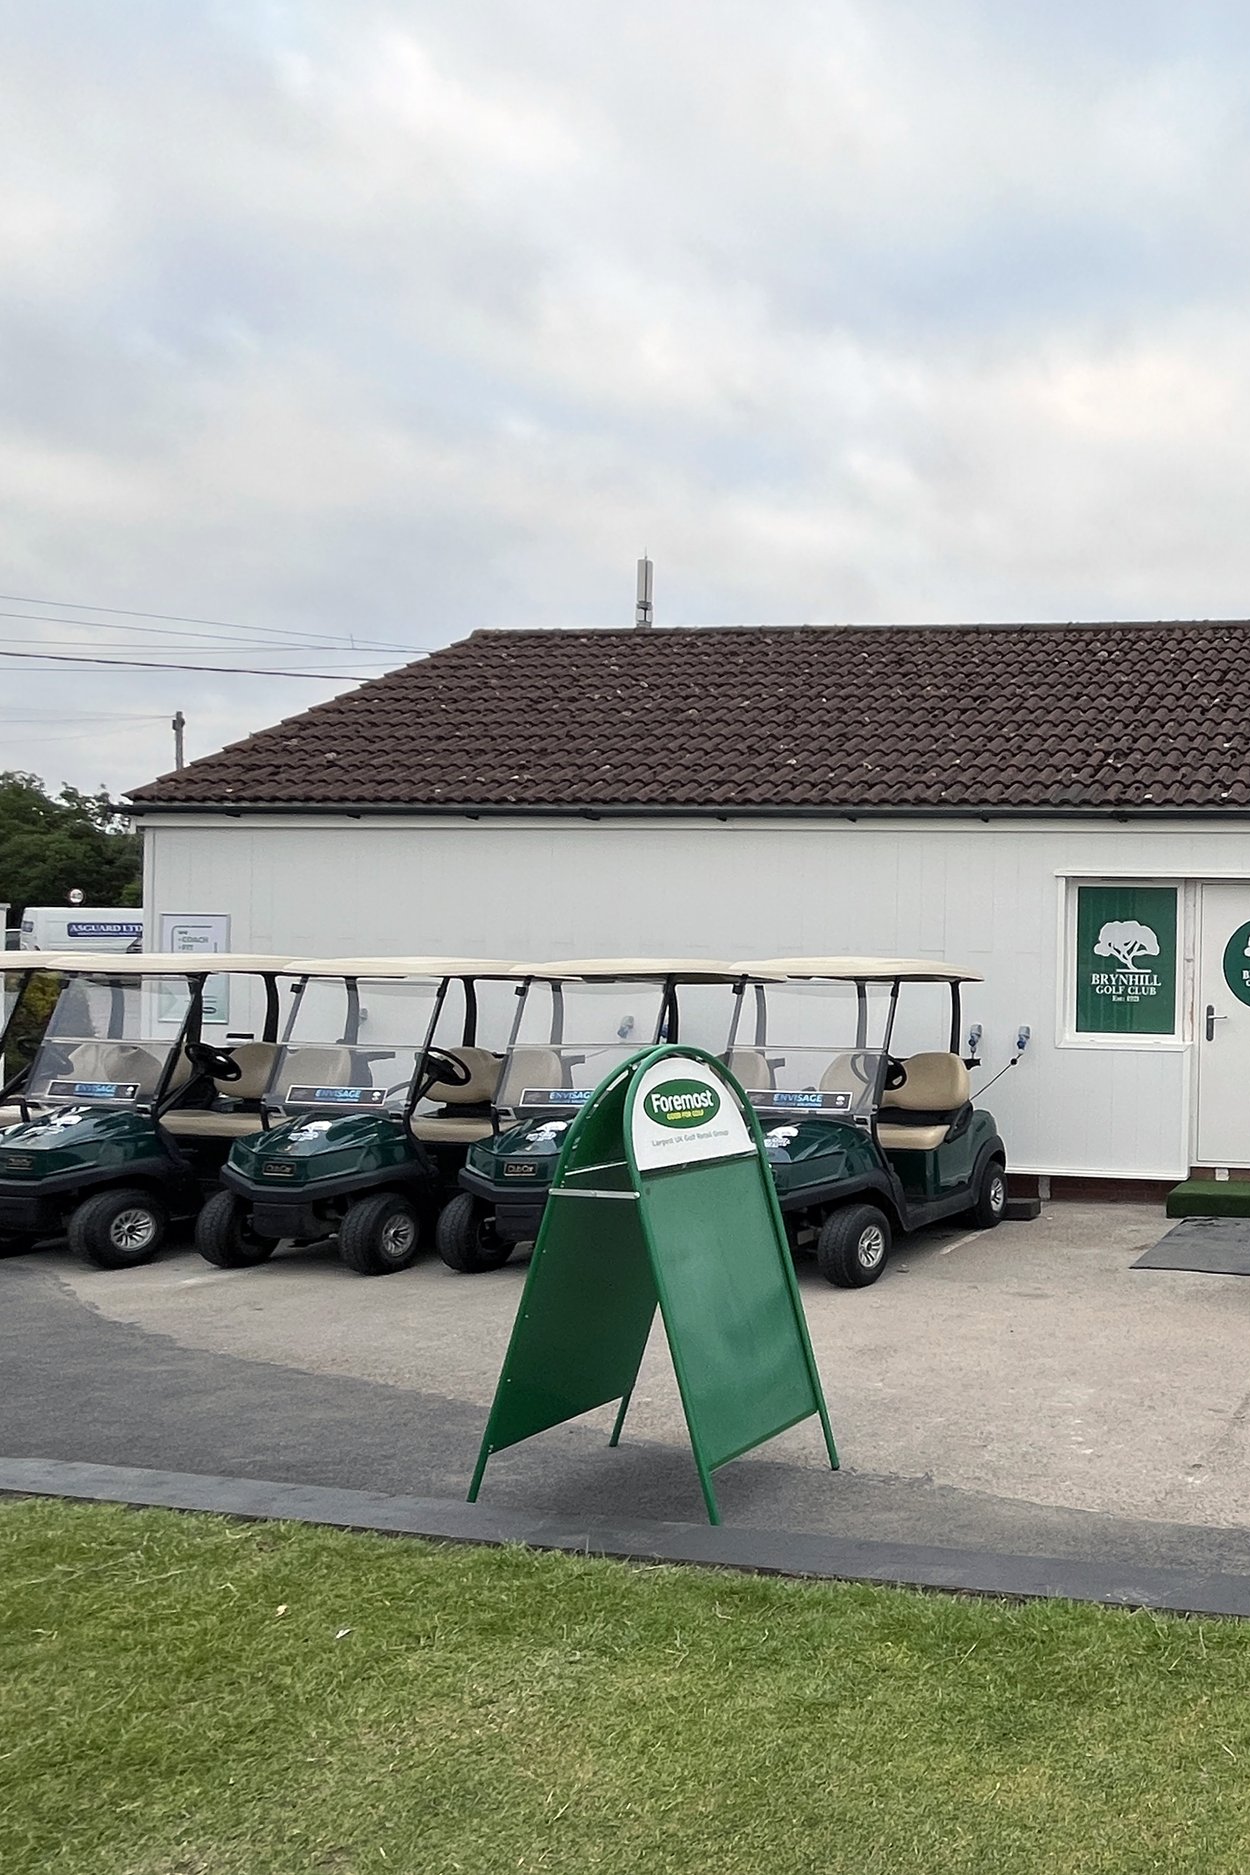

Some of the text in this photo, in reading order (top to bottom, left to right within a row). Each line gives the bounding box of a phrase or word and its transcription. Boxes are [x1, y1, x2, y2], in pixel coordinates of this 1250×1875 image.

[70, 924, 143, 932] ASGUARD LTD
[1091, 973, 1162, 986] BRYNHILL
[1095, 985, 1157, 995] GOLF CLUB
[315, 1089, 361, 1098] ENVISAGE
[549, 1091, 594, 1100] ENVISAG
[773, 1093, 823, 1102] ENVISAGE
[651, 1089, 715, 1114] Foremost
[652, 1137, 674, 1147] Largest
[675, 1135, 684, 1143] UK
